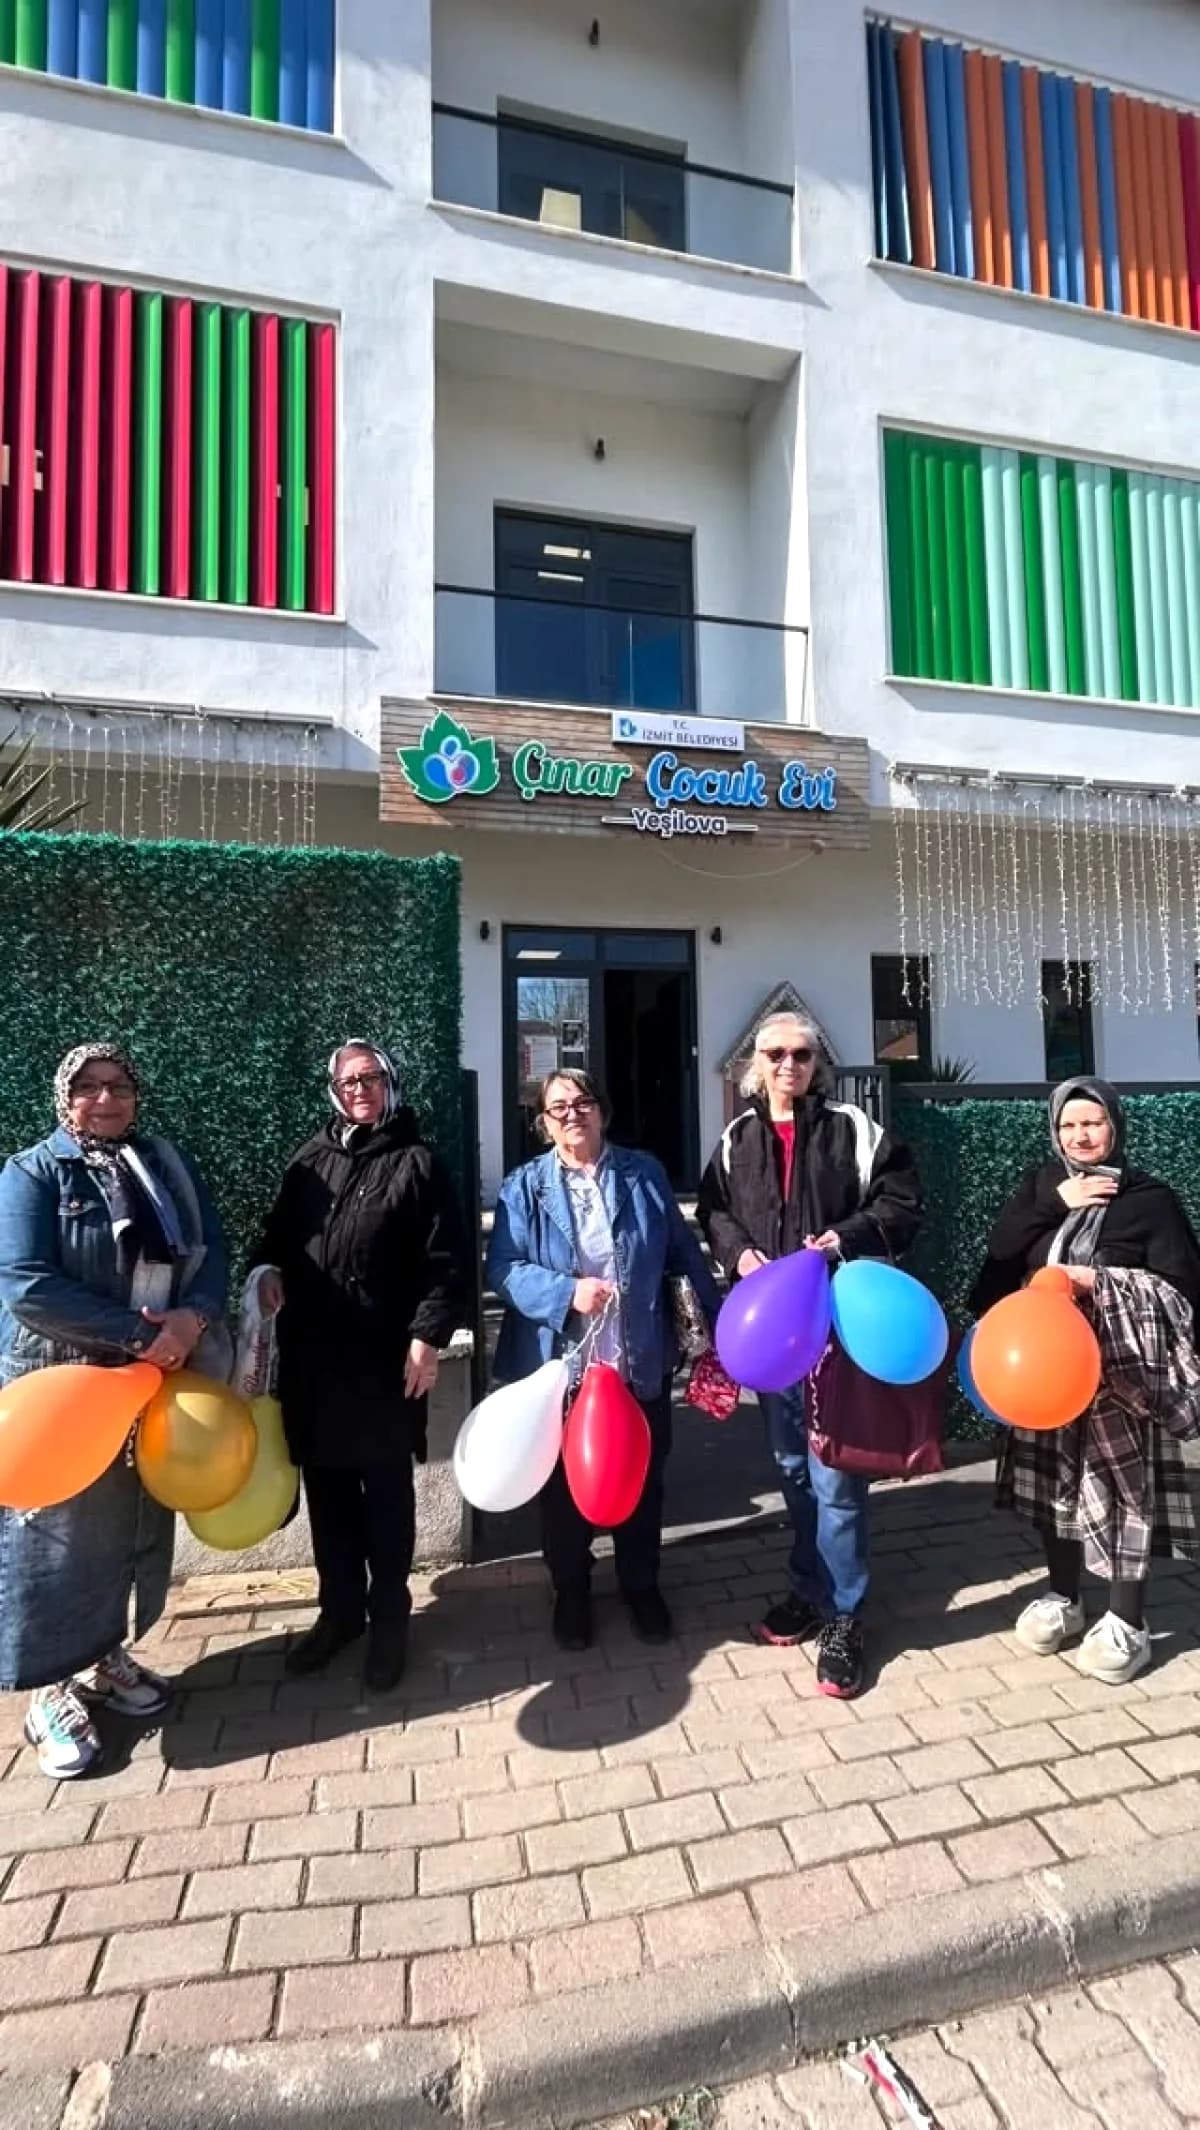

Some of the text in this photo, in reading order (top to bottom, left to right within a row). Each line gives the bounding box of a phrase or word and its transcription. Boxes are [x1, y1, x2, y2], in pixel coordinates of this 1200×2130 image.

[513, 740, 836, 809] Çınar Çocuk Evi
[632, 808, 727, 837] Yeşilova
